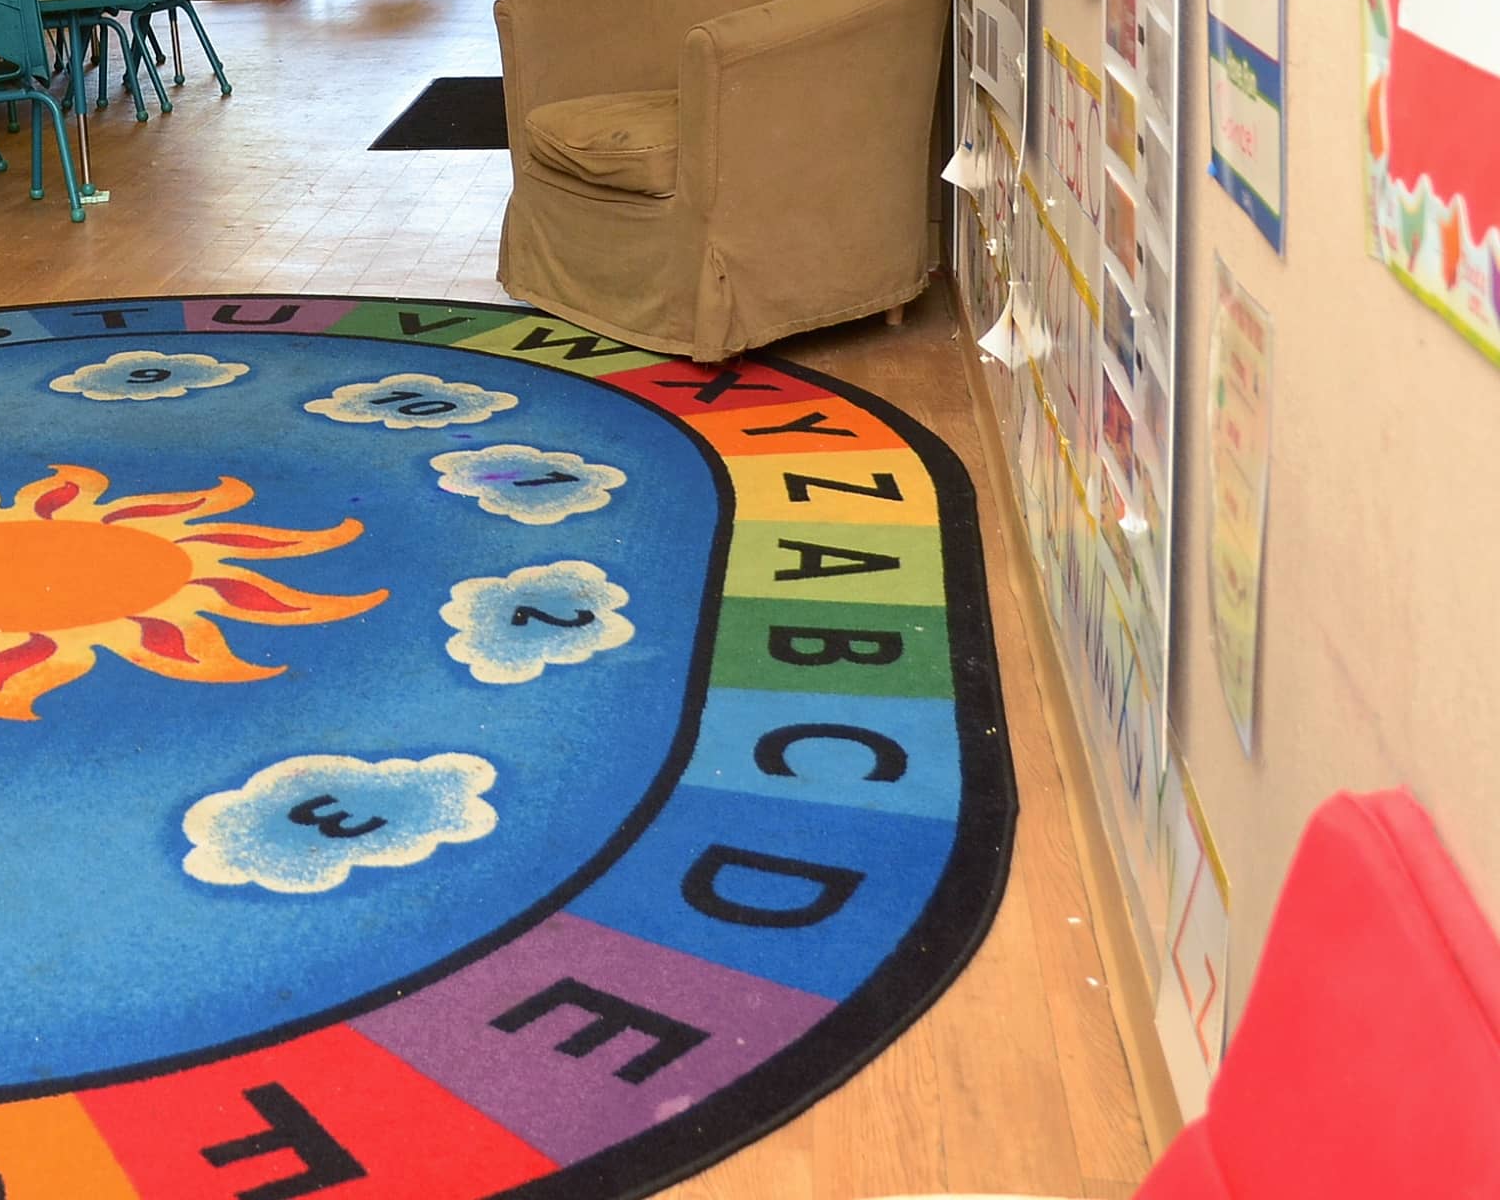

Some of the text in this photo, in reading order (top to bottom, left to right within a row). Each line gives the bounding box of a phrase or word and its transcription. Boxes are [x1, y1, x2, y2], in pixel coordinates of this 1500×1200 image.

[71, 308, 150, 329] T
[212, 304, 300, 327] U
[397, 313, 475, 338] V
[513, 327, 636, 361] W
[126, 368, 173, 385] 9
[652, 371, 785, 402] X
[371, 390, 459, 418] 10
[742, 411, 859, 438] Y
[513, 471, 580, 489] 1
[782, 471, 905, 504] Z
[774, 538, 901, 583] A
[510, 604, 597, 629] 2
[767, 626, 905, 666] B
[752, 722, 908, 784] C
[287, 794, 388, 840] 3
[682, 843, 868, 929] D
[487, 976, 712, 1086] E
[199, 1081, 369, 1200] F
